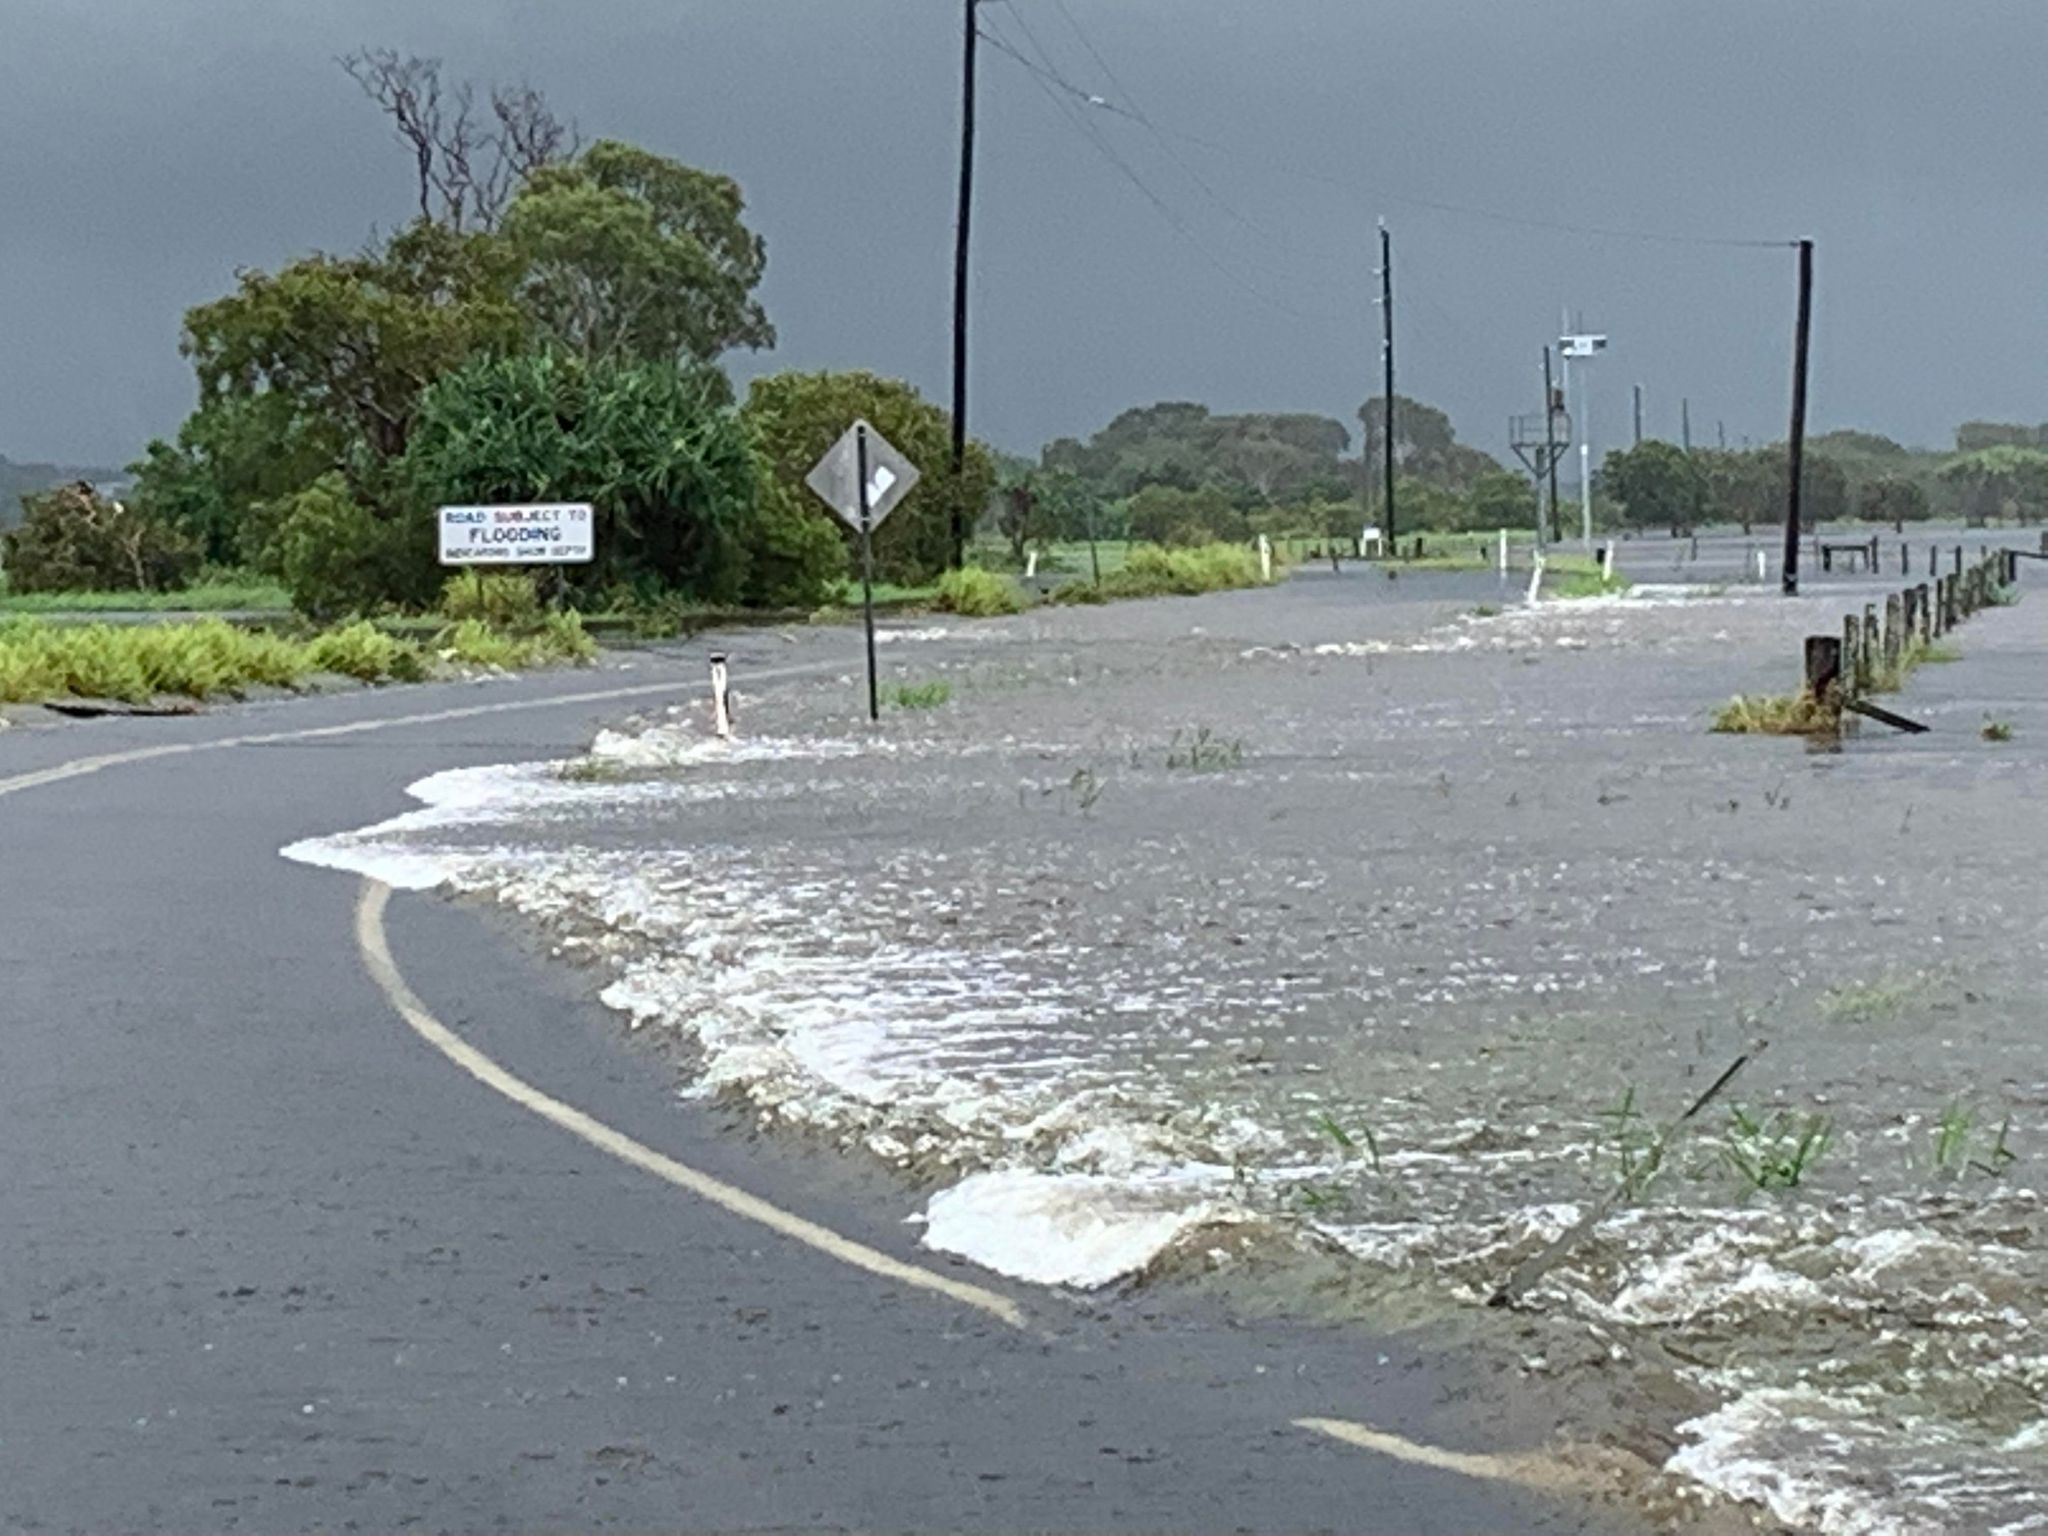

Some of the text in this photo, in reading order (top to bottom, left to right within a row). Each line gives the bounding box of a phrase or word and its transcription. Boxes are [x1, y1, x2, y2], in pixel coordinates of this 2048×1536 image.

[446, 509, 586, 523] ROAD SUBJECT TO
[469, 526, 561, 543] FLOODING
